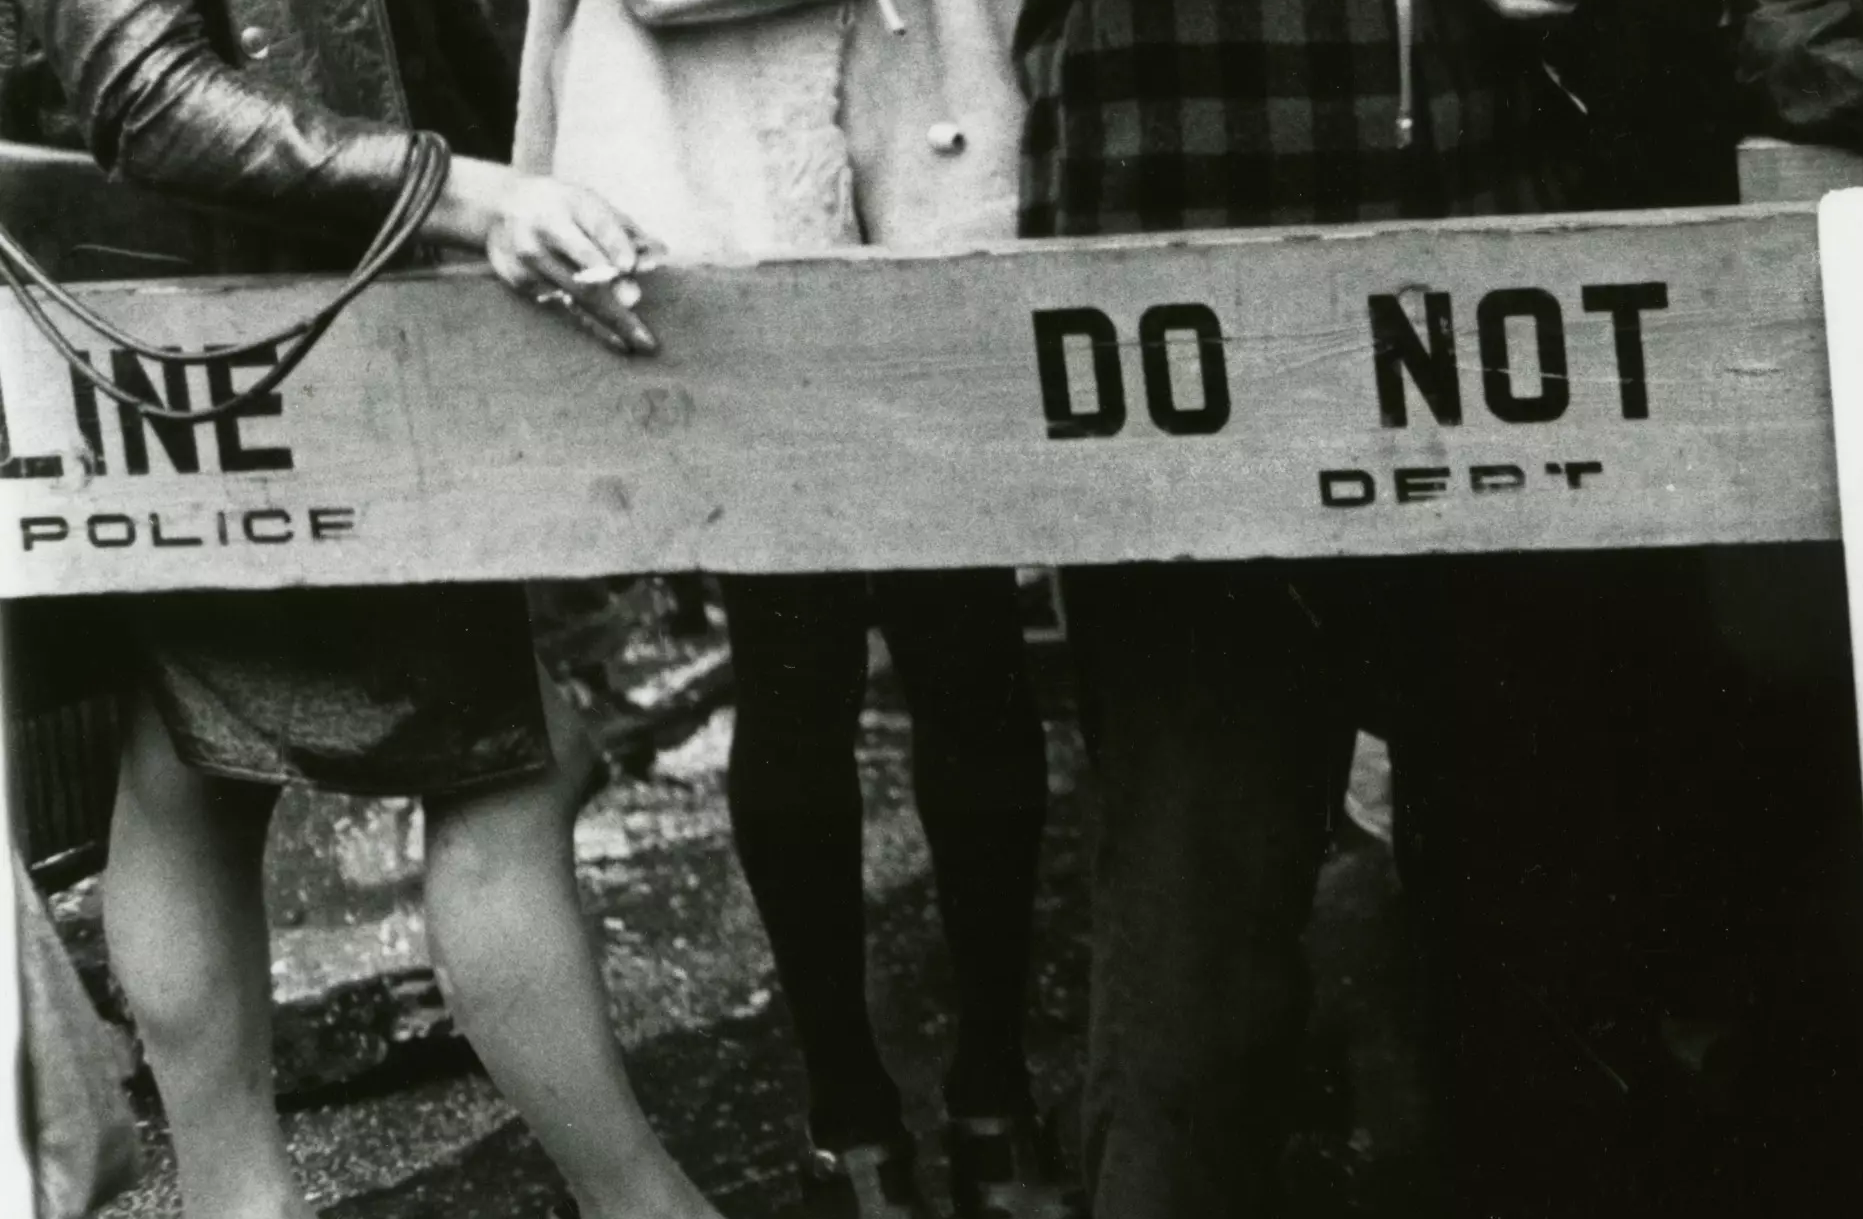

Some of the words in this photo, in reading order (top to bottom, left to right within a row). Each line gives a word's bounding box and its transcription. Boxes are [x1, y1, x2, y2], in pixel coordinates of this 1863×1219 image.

[1031, 302, 1233, 440] DO
[1367, 281, 1670, 429] NOT
[19, 508, 357, 552] POLICE
